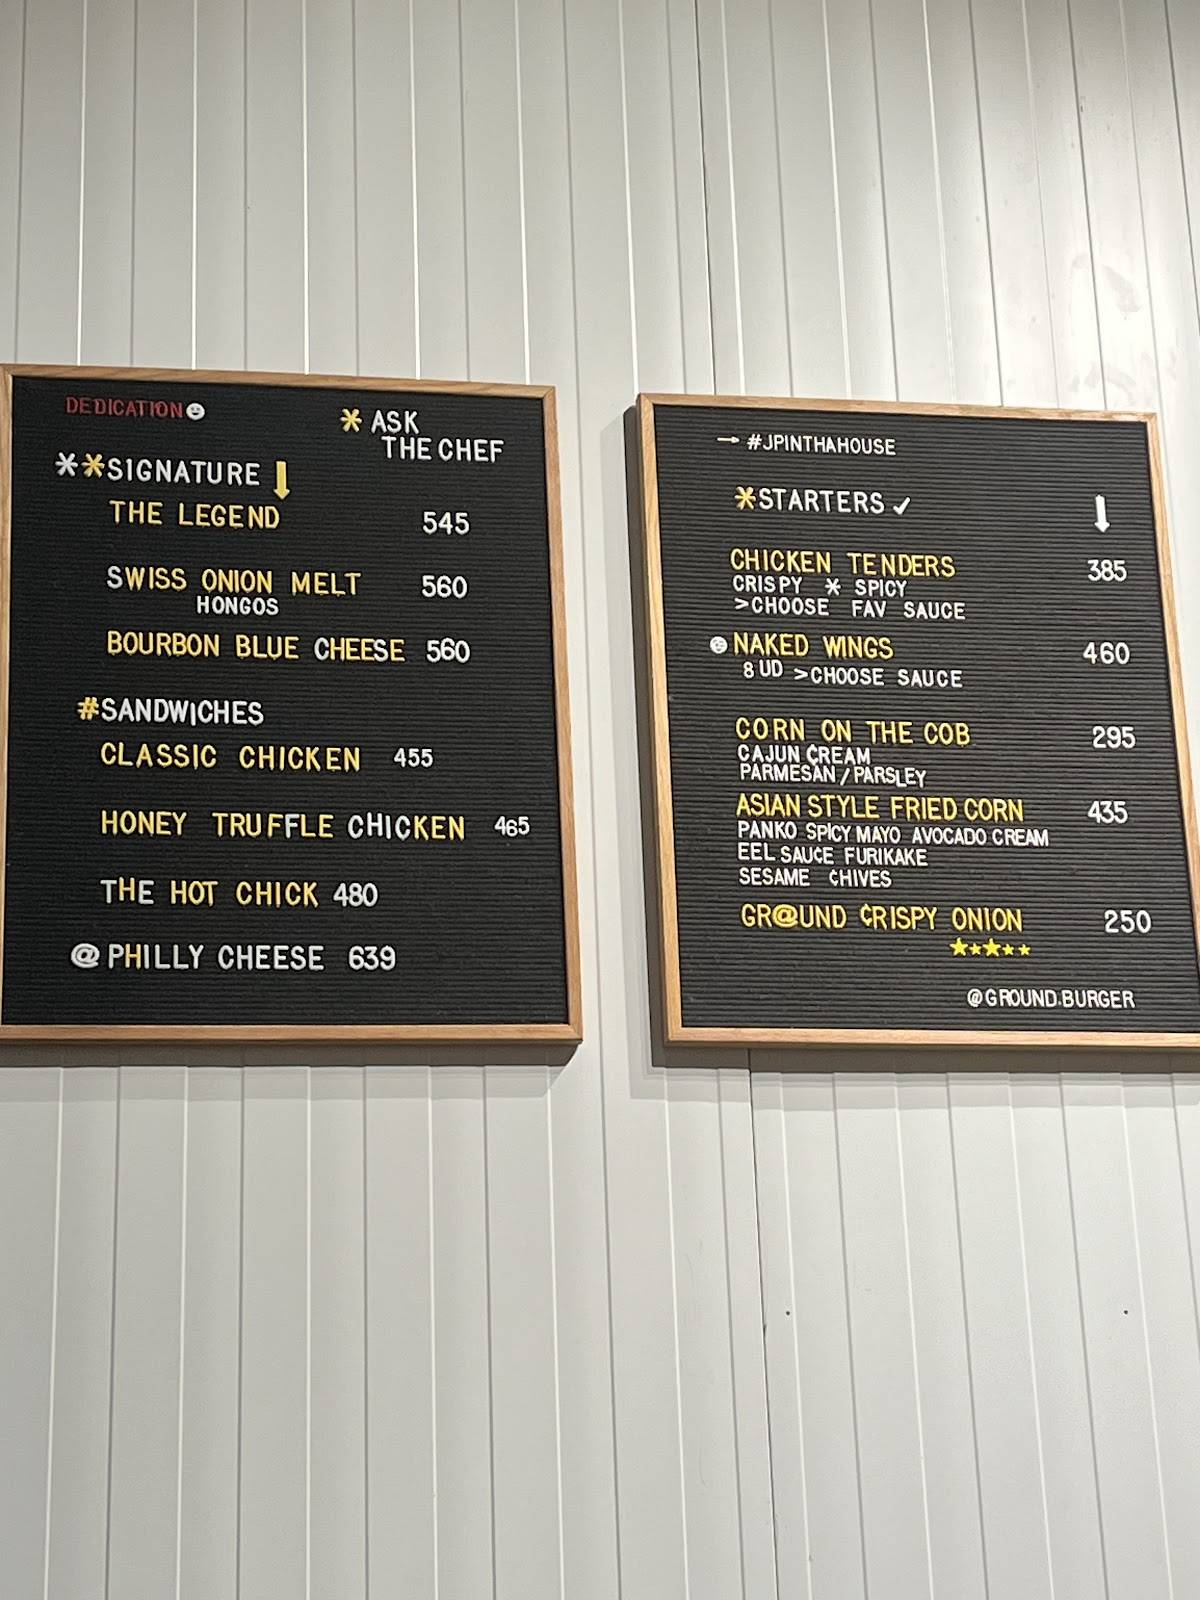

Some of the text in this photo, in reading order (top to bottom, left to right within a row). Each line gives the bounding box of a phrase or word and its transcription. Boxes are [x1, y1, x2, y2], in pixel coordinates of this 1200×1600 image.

[65, 396, 184, 418] DEDICATION
[371, 409, 419, 435] ASK
[381, 435, 504, 463] THE CHEF
[109, 500, 470, 535] THE LEGEND 545
[730, 548, 1127, 582] CHICKEN TENDERS 385
[106, 565, 468, 599] SWISS ONION MELT 560
[732, 576, 907, 598] CRISPY SPICY
[196, 595, 279, 616] HONGOS
[851, 599, 887, 618] FAV
[903, 601, 966, 620] SAUCE
[107, 630, 471, 663] BOURBON BLUE CHEESE 560
[733, 631, 1130, 665] NAKED WINGS 460
[897, 668, 963, 688] SAUCE
[735, 717, 1136, 749] CORN ON THE COB 295
[100, 741, 434, 772] CLASSIC CHICKEN 455
[737, 743, 801, 765] CAJUN
[736, 792, 1128, 824] ASIAN STYLE FRIED CORN 435
[101, 809, 530, 841] HONEY TRUFFLE CHICKEN 465
[737, 820, 1049, 847] PANKO SPICY MAYO AVOCADO CREAM
[737, 842, 776, 861] EEL
[844, 848, 929, 867] FURIKAKE
[739, 867, 811, 887] SESAME
[100, 876, 378, 908] THE HOT CHICK 480
[741, 903, 847, 929] GR@UND
[951, 906, 1023, 933] ONION
[1104, 909, 1152, 934] 250
[217, 944, 324, 971] CHEESE
[348, 945, 396, 971] 639
